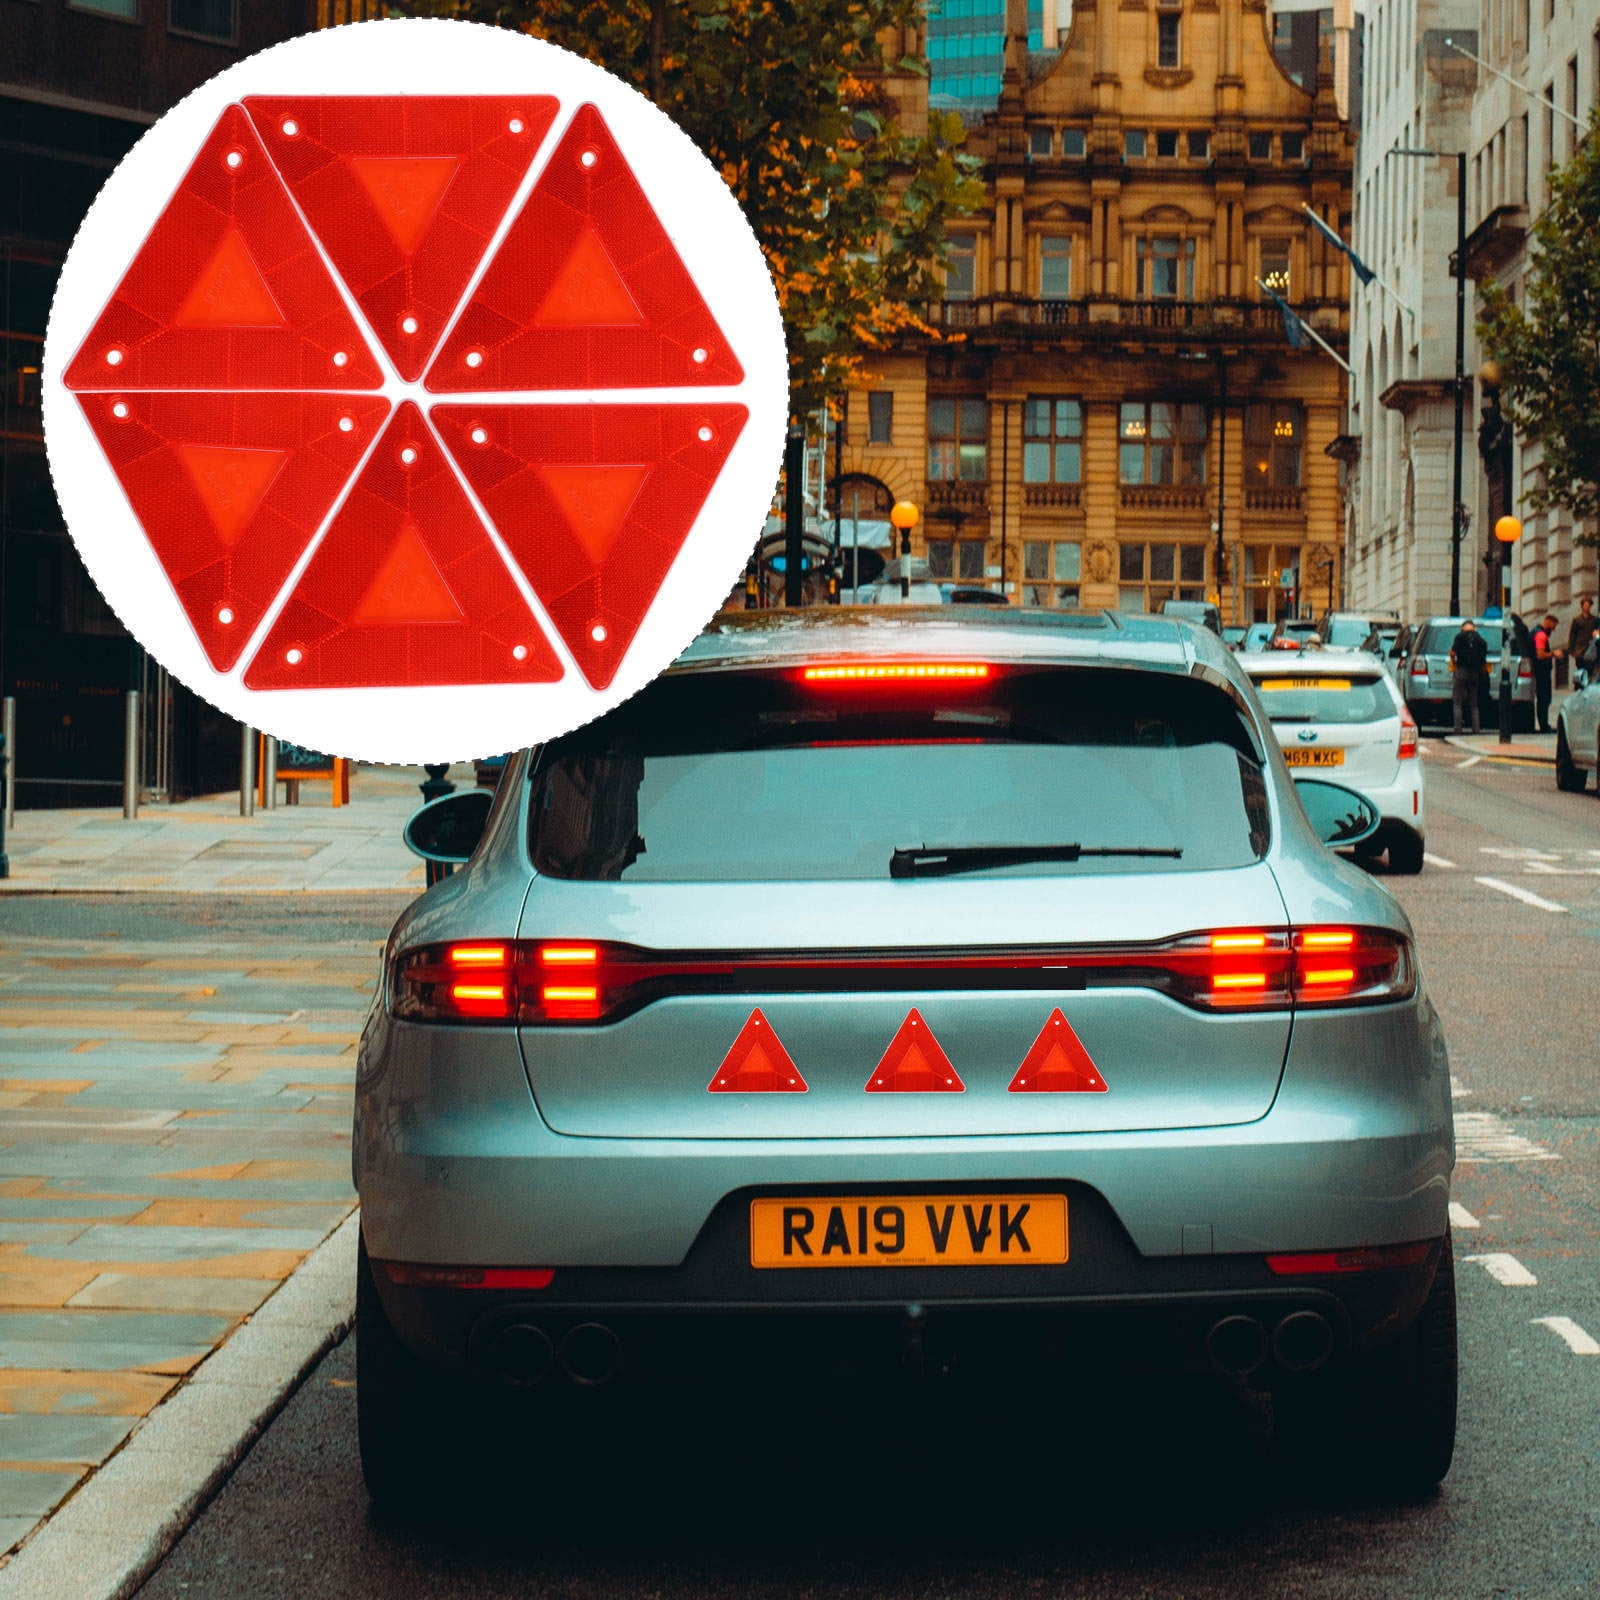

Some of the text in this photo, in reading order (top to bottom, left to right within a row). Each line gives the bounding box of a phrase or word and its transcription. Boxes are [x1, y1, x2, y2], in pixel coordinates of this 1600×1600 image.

[1313, 750, 1338, 763] WXC
[783, 1204, 1031, 1256] RA19 VVK
